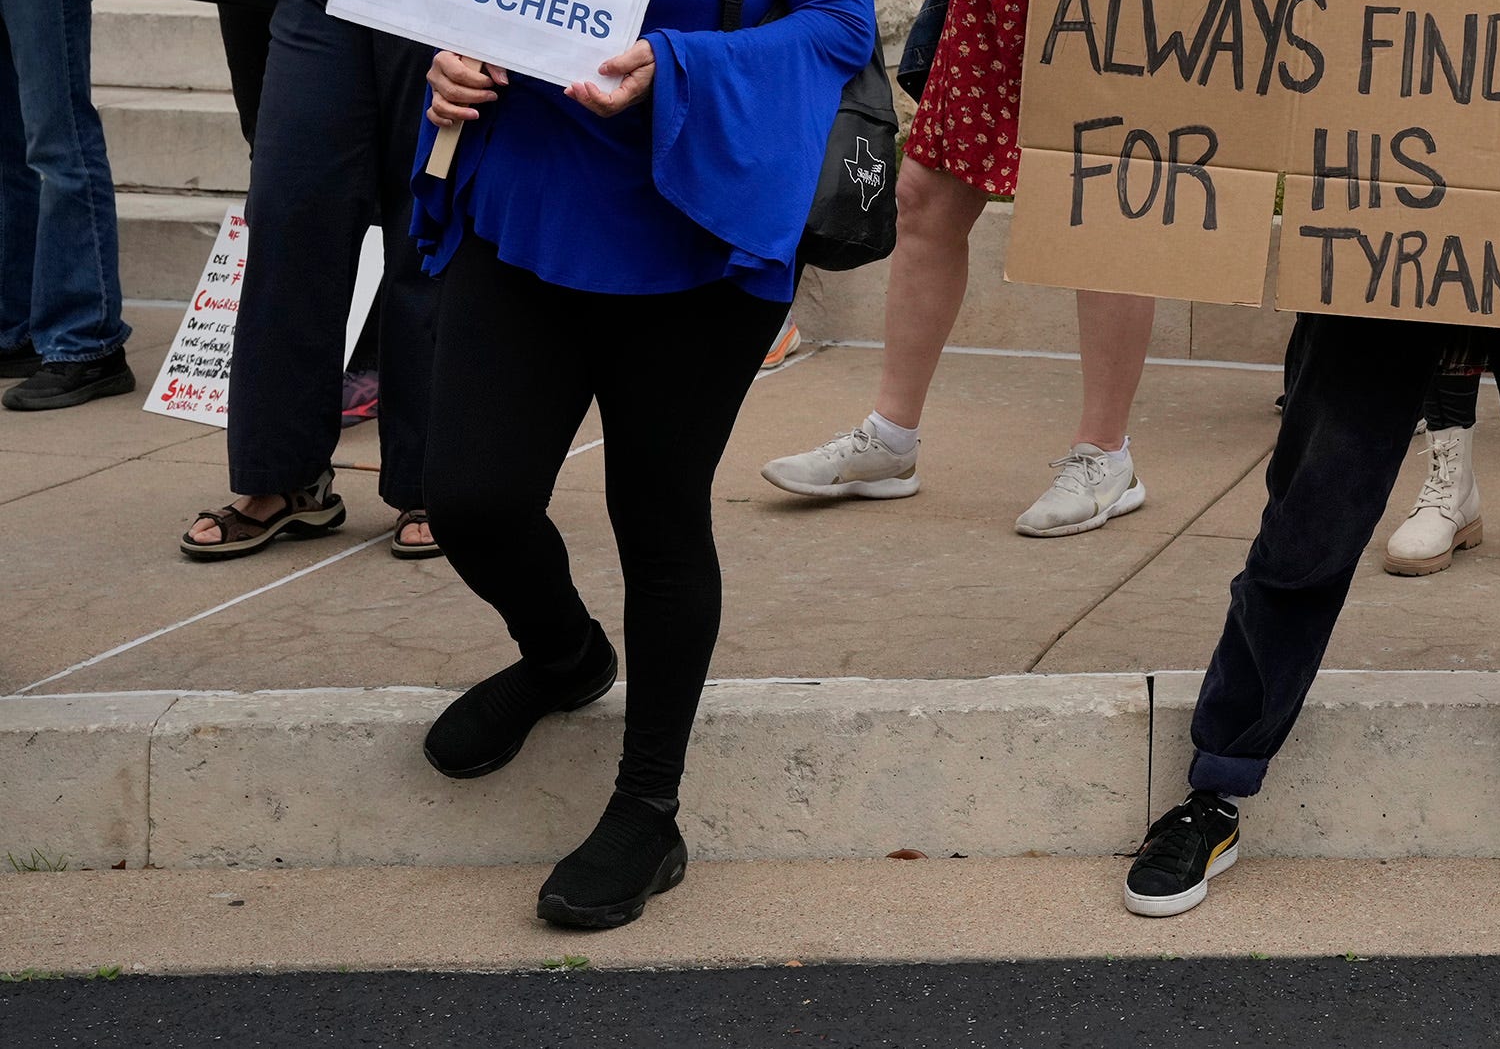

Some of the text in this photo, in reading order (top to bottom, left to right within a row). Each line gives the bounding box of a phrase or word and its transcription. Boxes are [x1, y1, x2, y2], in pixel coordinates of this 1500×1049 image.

[1070, 116, 1220, 230] FOR
[1312, 126, 1447, 212] HIS
[194, 290, 239, 311] CONGRES
[161, 378, 206, 402] SHAME
